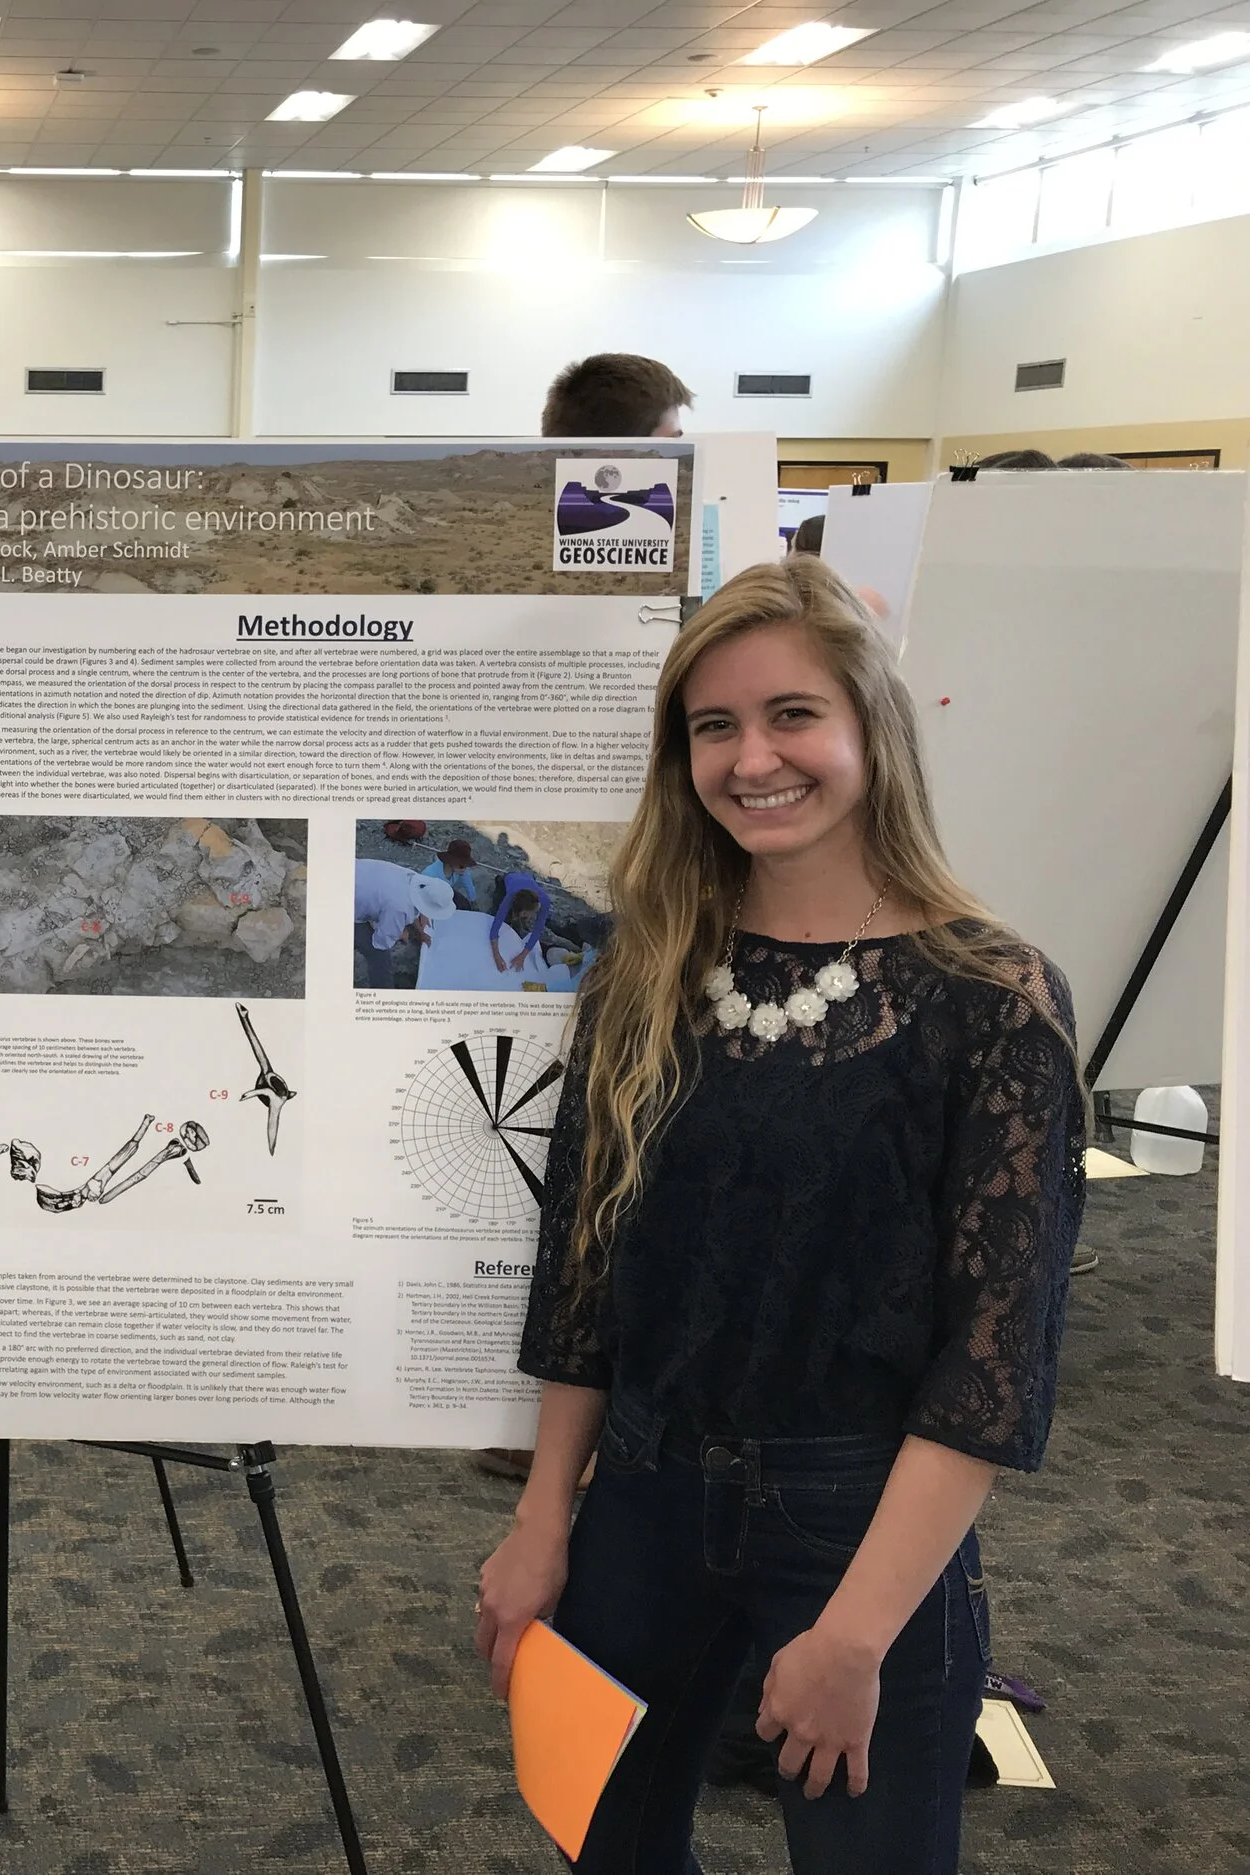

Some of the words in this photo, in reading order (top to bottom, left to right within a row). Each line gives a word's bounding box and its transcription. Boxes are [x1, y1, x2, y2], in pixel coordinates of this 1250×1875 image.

[0, 460, 31, 488] of
[38, 468, 53, 489] a
[65, 462, 203, 490] Dinosaur:
[20, 502, 176, 536] prehistoric
[185, 506, 376, 532] environment
[44, 540, 108, 558] Amber
[112, 541, 190, 558] Schmidt
[559, 538, 594, 546] WINONA
[597, 539, 620, 547] STATE
[622, 539, 669, 547] UNIVERSITY
[560, 547, 668, 565] GEOSCIENCE
[22, 566, 82, 587] Beatty
[238, 614, 414, 641] Methodology
[5, 645, 27, 655] began
[42, 645, 87, 655] investigation
[88, 645, 97, 656] by
[98, 646, 137, 656] numbering
[137, 646, 155, 654] each
[156, 646, 164, 654] of
[165, 646, 178, 654] the
[178, 646, 215, 654] hadrosaur
[215, 646, 251, 655] vertebrae
[263, 647, 278, 656] site,
[279, 647, 293, 655] and
[294, 647, 312, 655] after
[313, 647, 322, 655] all
[323, 647, 358, 655] vertebrae
[379, 647, 419, 656] numbered,
[426, 647, 442, 657] grid
[459, 647, 483, 657] placed
[502, 648, 515, 656] the
[516, 648, 538, 656] entire
[538, 648, 580, 658] assemblage
[592, 648, 607, 656] that
[614, 650, 631, 658] map
[632, 649, 641, 657] of
[641, 649, 659, 657] their
[210, 1090, 228, 1100] C-9
[155, 1123, 174, 1132] C-8
[71, 1157, 89, 1166] C-7
[246, 1204, 264, 1214] 7.5
[268, 1206, 285, 1214] cm
